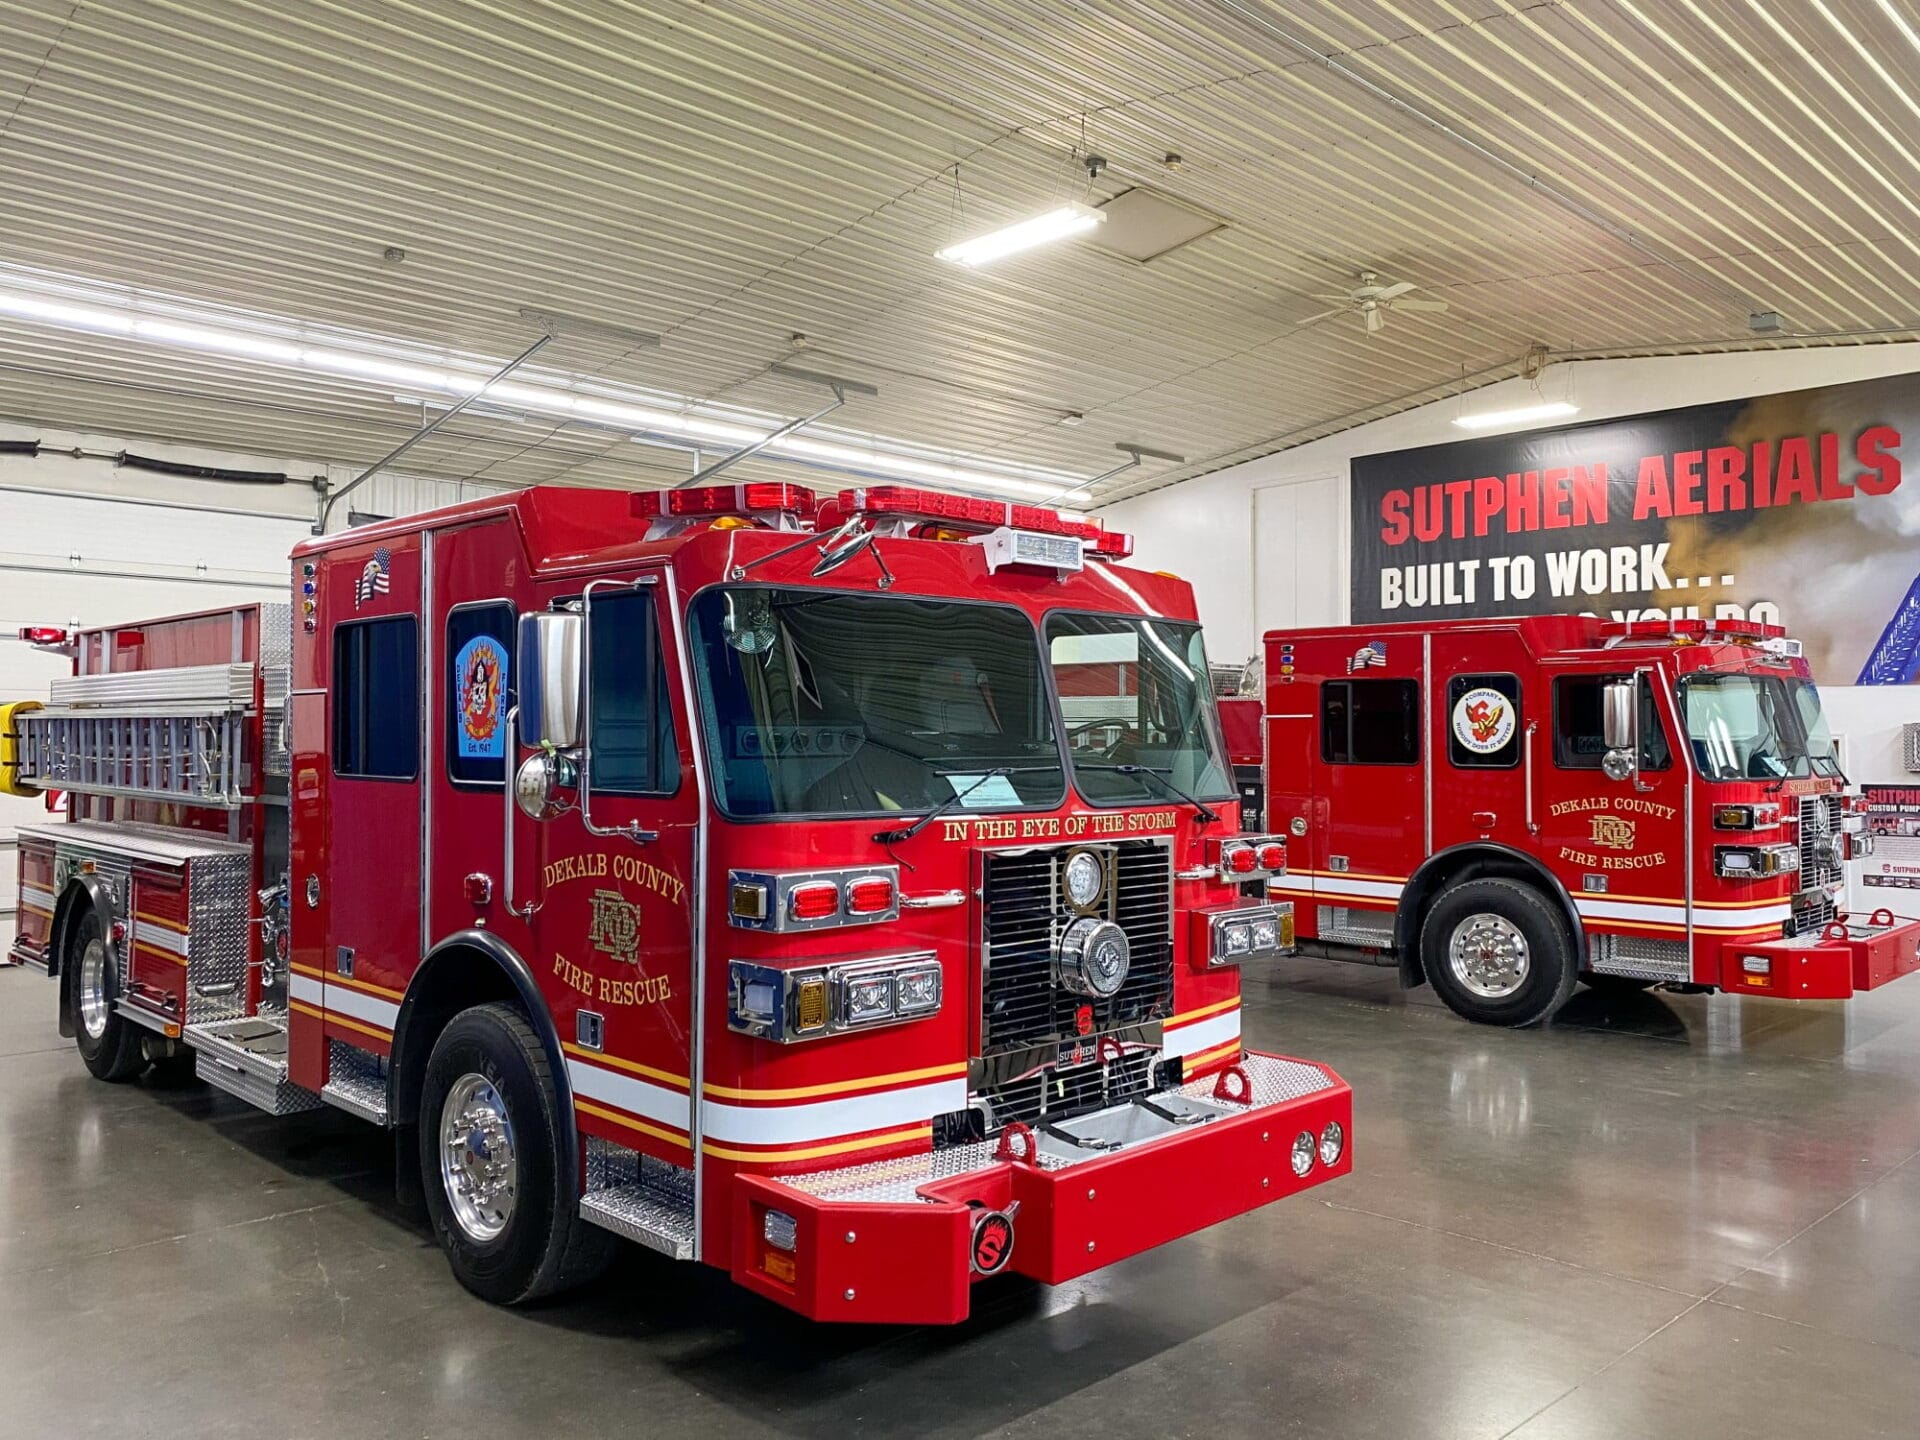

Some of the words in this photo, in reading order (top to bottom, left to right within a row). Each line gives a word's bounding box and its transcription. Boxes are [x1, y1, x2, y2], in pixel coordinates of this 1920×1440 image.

[1381, 463, 1609, 546] SUTPHEN
[1633, 425, 1902, 521] AERIALS
[1381, 559, 1480, 610] BUILT
[1489, 555, 1535, 602] TO
[1468, 691, 1499, 700] COMPANY
[1456, 722, 1472, 745] NOBODY
[1496, 722, 1512, 745] BETTER
[1550, 797, 1609, 816] DEKALB
[1614, 797, 1677, 820] COUNTY
[1868, 804, 1897, 812] CUSTOM
[943, 822, 968, 841] IN
[974, 820, 1017, 840] THE
[1022, 817, 1060, 838] EYE
[1064, 816, 1088, 835] OF
[1092, 815, 1124, 833] THE
[1128, 812, 1177, 831] STORM
[1559, 847, 1597, 867] FIRE
[1602, 852, 1666, 869] RESCUE
[544, 853, 607, 888] DEKALB
[613, 854, 685, 905] COUNTY
[552, 953, 594, 997] FIRE
[599, 974, 671, 1006] RESCUE
[1059, 1044, 1096, 1062] SUTPHEN
